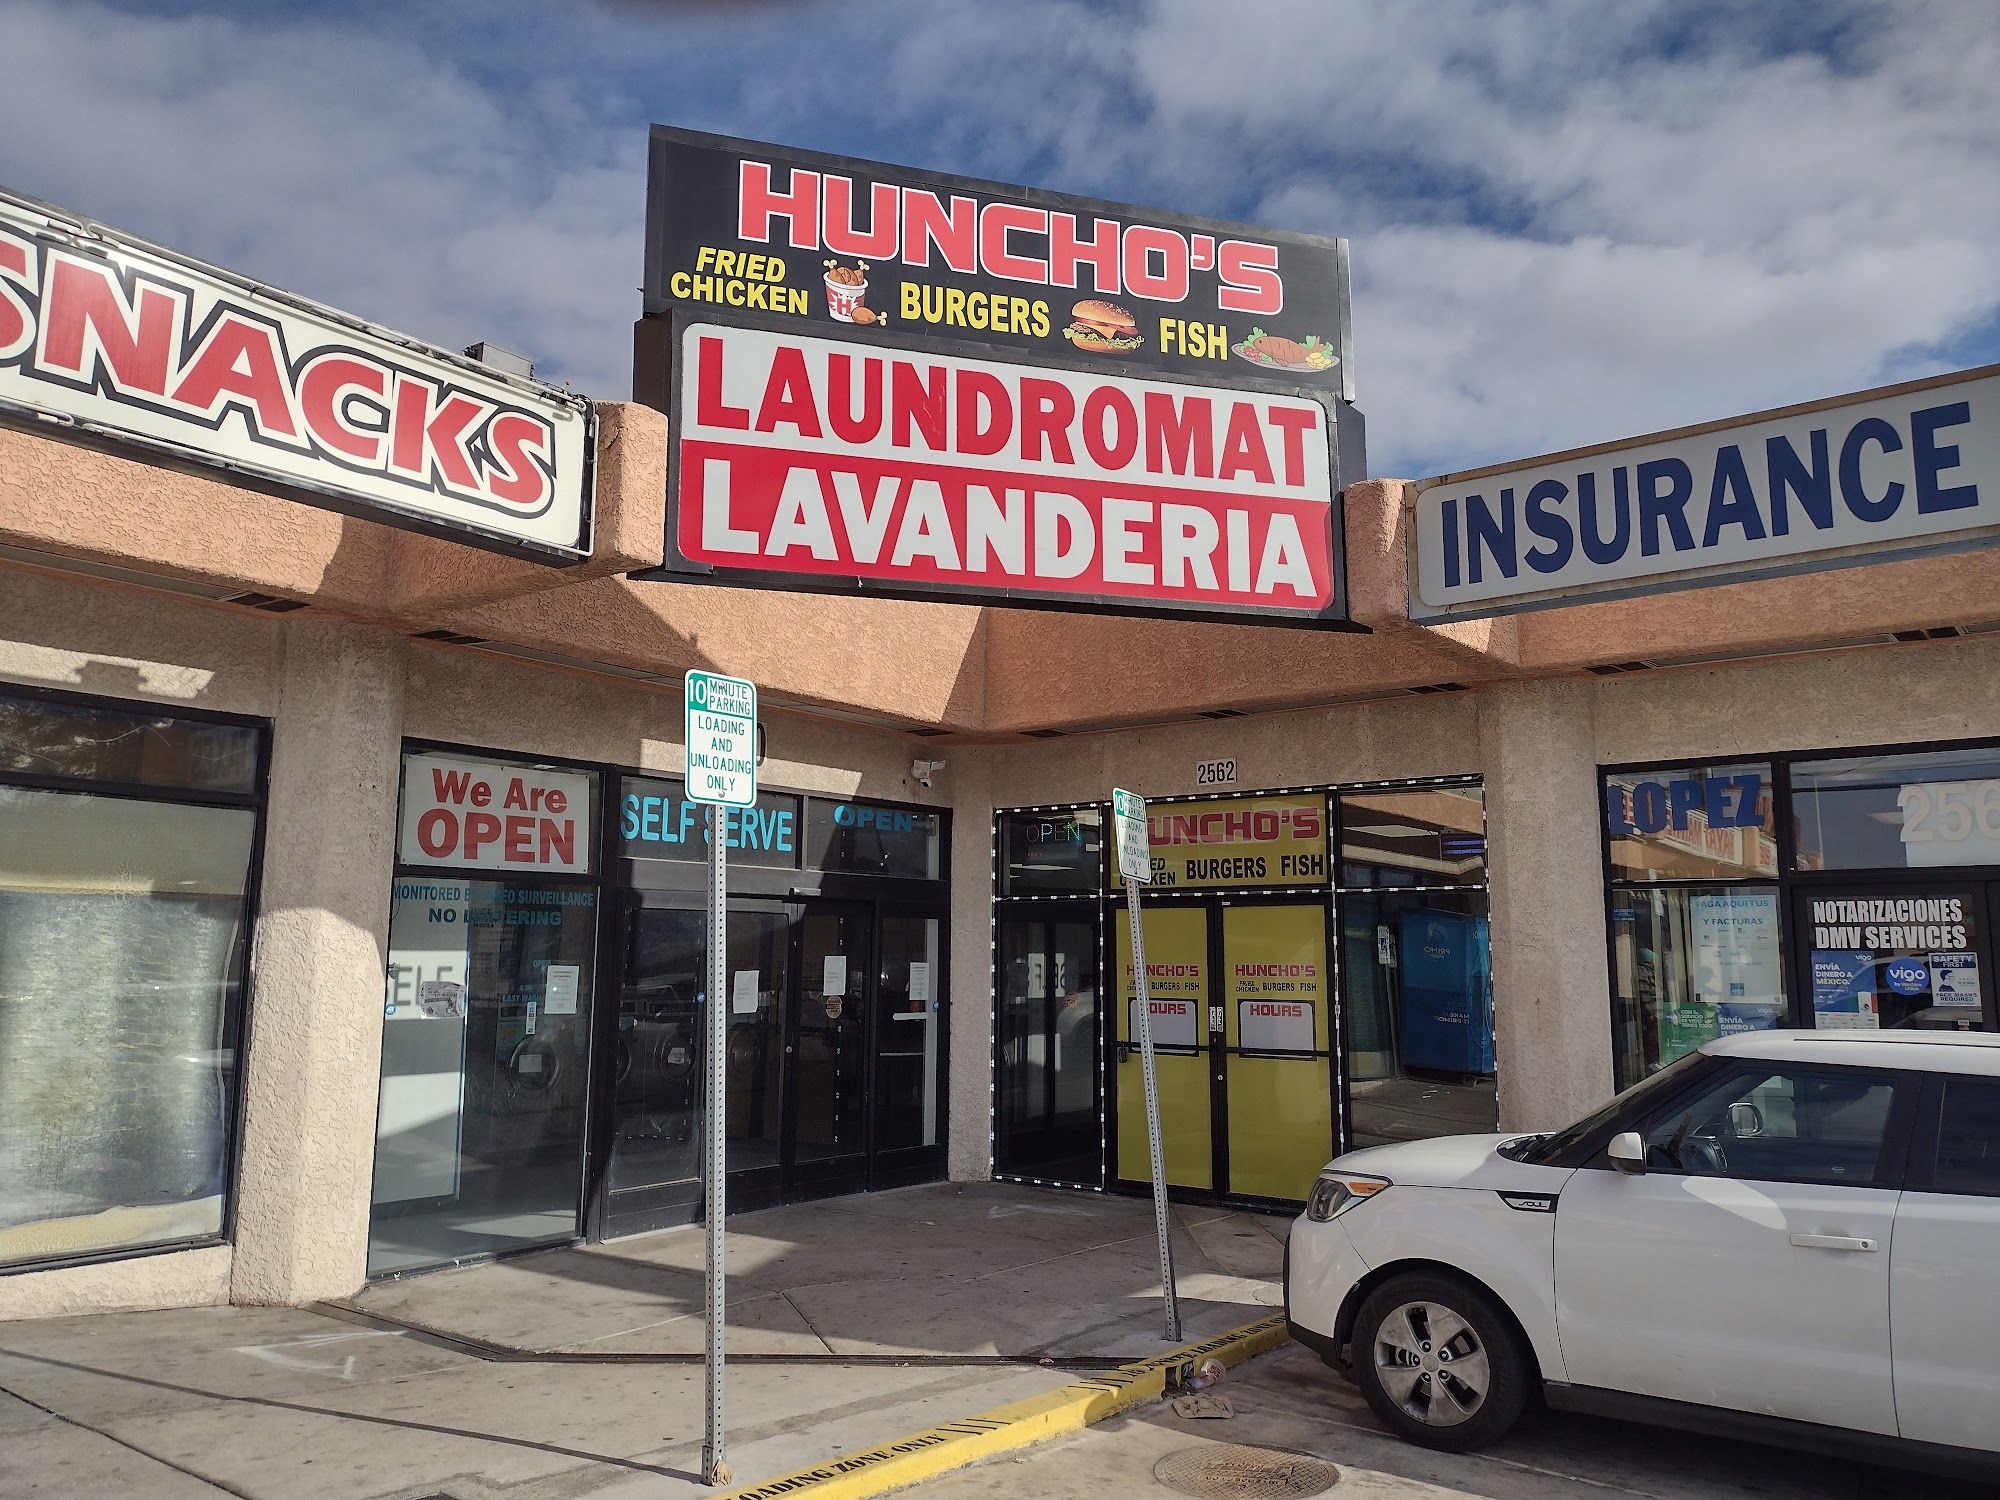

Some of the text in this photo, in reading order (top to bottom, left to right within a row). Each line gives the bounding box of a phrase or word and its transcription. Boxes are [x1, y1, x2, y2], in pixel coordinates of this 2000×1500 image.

[738, 159, 1285, 316] HUNCHO'S
[695, 245, 787, 284] FRIED
[670, 270, 809, 316] CHICKEN
[900, 280, 1230, 362] BURGERS FISH
[696, 335, 1318, 488] LAUNDROMAT
[1440, 400, 1980, 589] INSURANCE
[700, 457, 1319, 599] LAVANDERIA
[688, 678, 707, 705] 10
[709, 695, 751, 716] PARKING
[698, 714, 745, 736] LOADING
[711, 736, 733, 753] AND
[690, 752, 752, 774] UNLOADING
[1197, 760, 1236, 785] 2562
[431, 767, 568, 814] We Are
[706, 774, 736, 791] ONLY
[1608, 774, 1765, 836] LOPEZ
[620, 793, 697, 844] SELF
[833, 804, 913, 833] OPEN
[1148, 806, 1322, 848] UNCHO'S
[417, 808, 574, 866] OPEN
[1027, 821, 1081, 843] OPEN
[1186, 856, 1267, 880] BURGERS
[1281, 854, 1324, 877] FISH
[392, 884, 594, 907] MONITORED B DEO SURVEILLANCE
[428, 907, 457, 924] NO
[463, 908, 562, 926] LTERING
[1712, 918, 1764, 926] FACTURAS
[1813, 898, 1963, 924] NOTARIZACIONES
[1815, 925, 1967, 949] DMV SERVICES
[1126, 964, 1199, 977] HNCHO'S
[1234, 963, 1316, 978] HUNCHO'S
[1932, 955, 1973, 963] SAFETY
[1151, 981, 1200, 991] BURGERS FISH
[1889, 966, 1926, 982] vigo
[1262, 982, 1317, 992] BURGERS FISH
[1149, 1002, 1187, 1015] OURS
[1249, 1003, 1303, 1018] HOURS
[1518, 1200, 1548, 1208] SOUL
[830, 1450, 896, 1474] ZONE
[891, 1433, 948, 1453] ONLY
